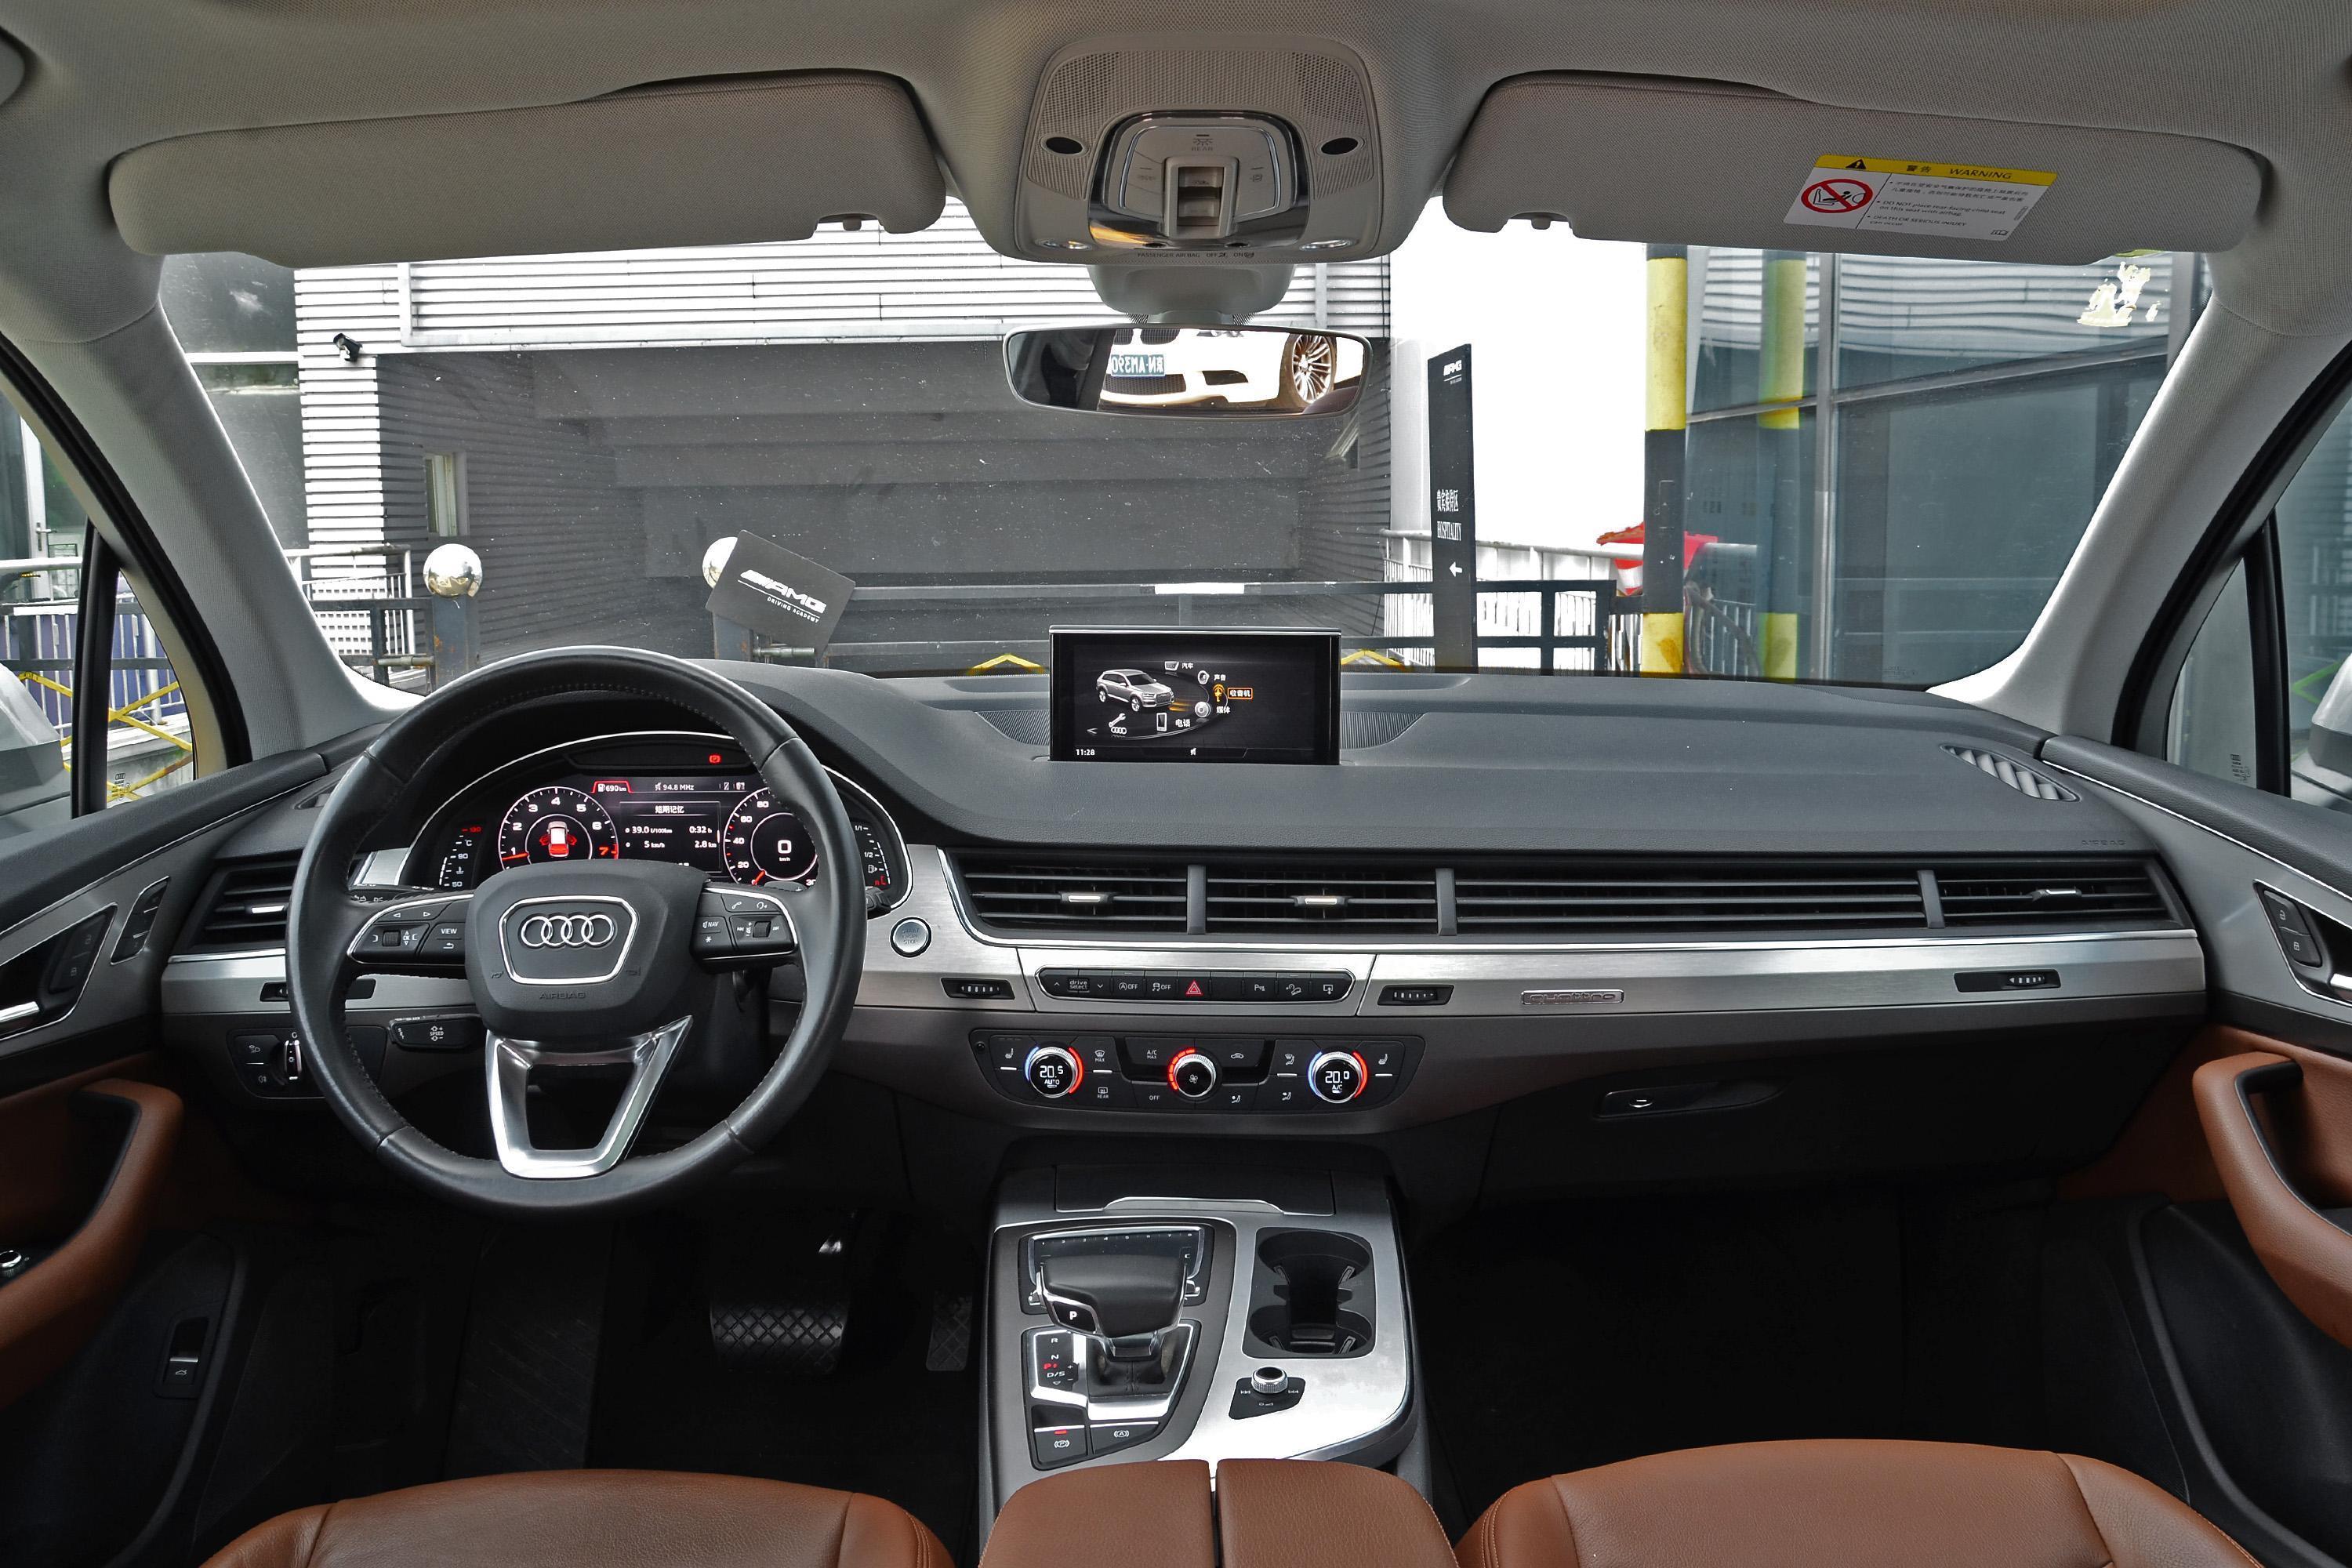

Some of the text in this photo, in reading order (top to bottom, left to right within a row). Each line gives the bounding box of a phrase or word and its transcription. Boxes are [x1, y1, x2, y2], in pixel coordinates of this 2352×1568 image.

[1950, 168, 2013, 180] WARNING
[767, 596, 819, 623] DRIVING ACADEMY
[1216, 706, 1231, 714] 媒体
[1175, 719, 1191, 728] 电话
[1076, 748, 1095, 757] 11:28
[551, 797, 561, 806] 4
[528, 804, 539, 812] 3
[576, 804, 587, 812] 5
[655, 805, 684, 814] 短期记忆
[512, 822, 523, 831] 2
[510, 847, 516, 855] 1
[599, 847, 609, 855] 7
[777, 840, 792, 854] 0
[539, 991, 586, 1000] AIRBAG
[1530, 992, 1616, 1004] quattro
[1069, 1311, 1077, 1321] P
